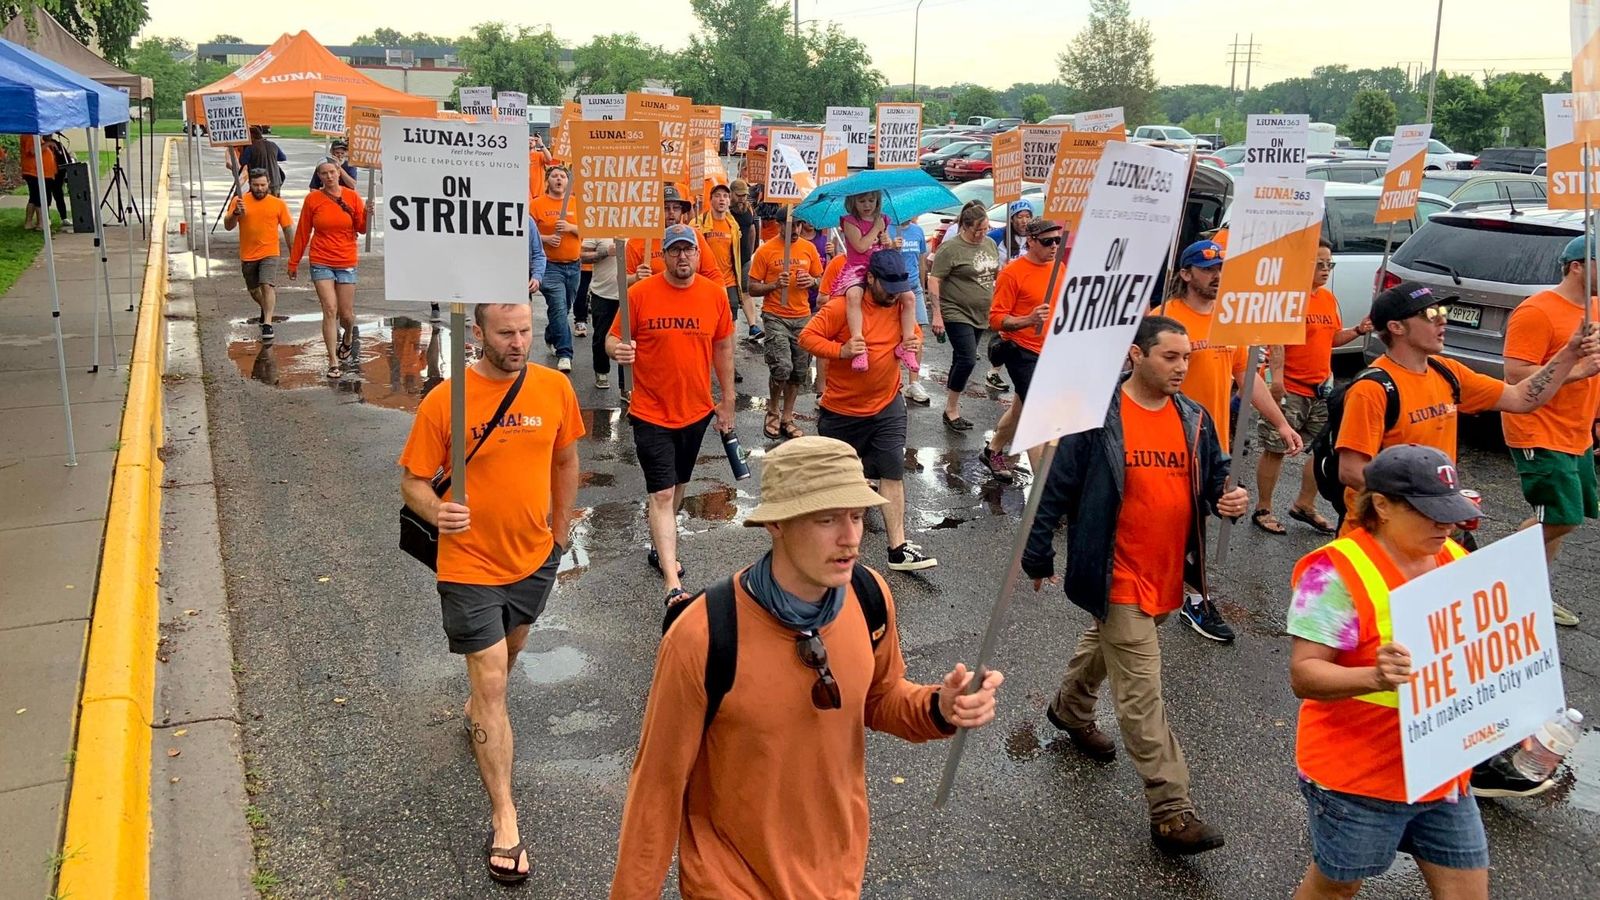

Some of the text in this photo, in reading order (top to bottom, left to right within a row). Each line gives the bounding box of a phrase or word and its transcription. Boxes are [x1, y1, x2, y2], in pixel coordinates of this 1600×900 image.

[207, 106, 243, 119] STRIKE!
[315, 103, 346, 114] STRIKE!
[462, 105, 492, 115] STRIKE!
[498, 107, 527, 117] STRIKE!
[210, 118, 246, 130] STRIKE!
[315, 112, 345, 123] STRIKE!
[689, 118, 719, 129] STRIKE!
[314, 121, 344, 132] STRIKE!
[353, 124, 381, 138] STRI
[880, 122, 919, 135] STRIKE!
[212, 129, 247, 141] STRIKE!
[880, 136, 918, 148] STRIKE!
[352, 137, 381, 151] STRI
[1024, 142, 1059, 153] STRIK
[1271, 138, 1284, 147] ON
[352, 150, 382, 164] STRI
[394, 155, 427, 164] PUBLIC
[431, 158, 485, 168] EMPLOYEES
[879, 150, 917, 162] STRIKE!
[1024, 154, 1056, 166] STRIK
[1247, 148, 1305, 164] STRIKE!
[580, 155, 658, 177] STRIKE!
[824, 162, 836, 175] ON
[1025, 166, 1049, 178] STRI
[1058, 158, 1099, 175] STRIK
[1398, 169, 1411, 187] ON
[442, 175, 471, 198] ON
[582, 181, 660, 203] STRIKE!
[1380, 188, 1418, 210] STRIKE!
[389, 195, 525, 237] STRIKE!
[584, 206, 661, 228] STRIKE!
[1104, 237, 1130, 272] ON
[1255, 256, 1284, 286] ON
[1053, 274, 1153, 336] STRIKE!
[1218, 291, 1306, 324] STRIKE!
[1124, 450, 1185, 468] LiUNA!
[1427, 581, 1509, 655] WE DO
[1407, 611, 1540, 716] THE WORK
[1408, 648, 1555, 743] that makes the City work!
